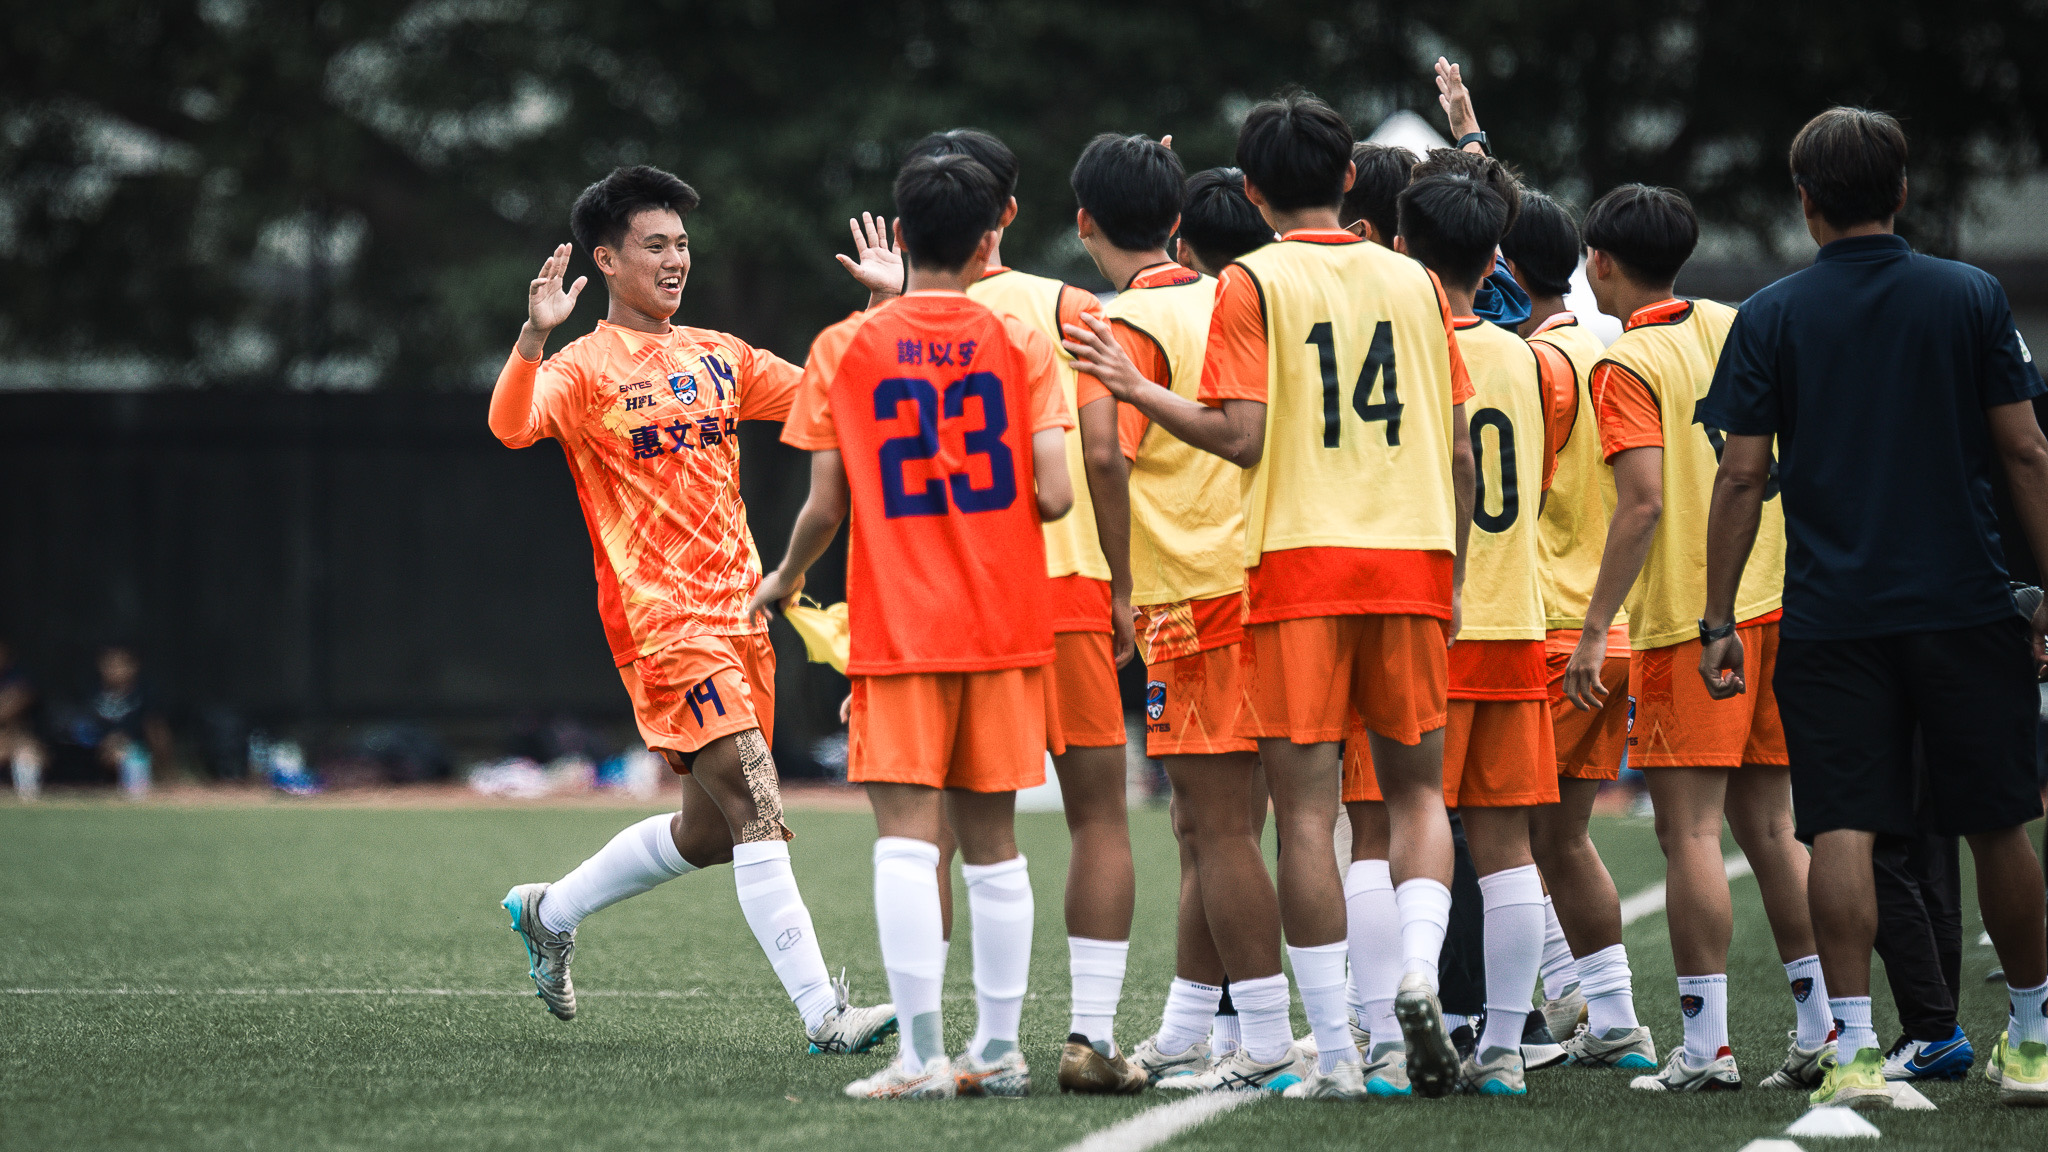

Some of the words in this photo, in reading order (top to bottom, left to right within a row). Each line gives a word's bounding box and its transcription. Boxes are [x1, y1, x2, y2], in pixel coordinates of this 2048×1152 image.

[619, 381, 652, 392] ENTES
[700, 354, 736, 400] 14
[1305, 320, 1404, 448] 14
[626, 394, 656, 411] HFL
[873, 371, 1017, 519] 23
[684, 676, 726, 729] 14
